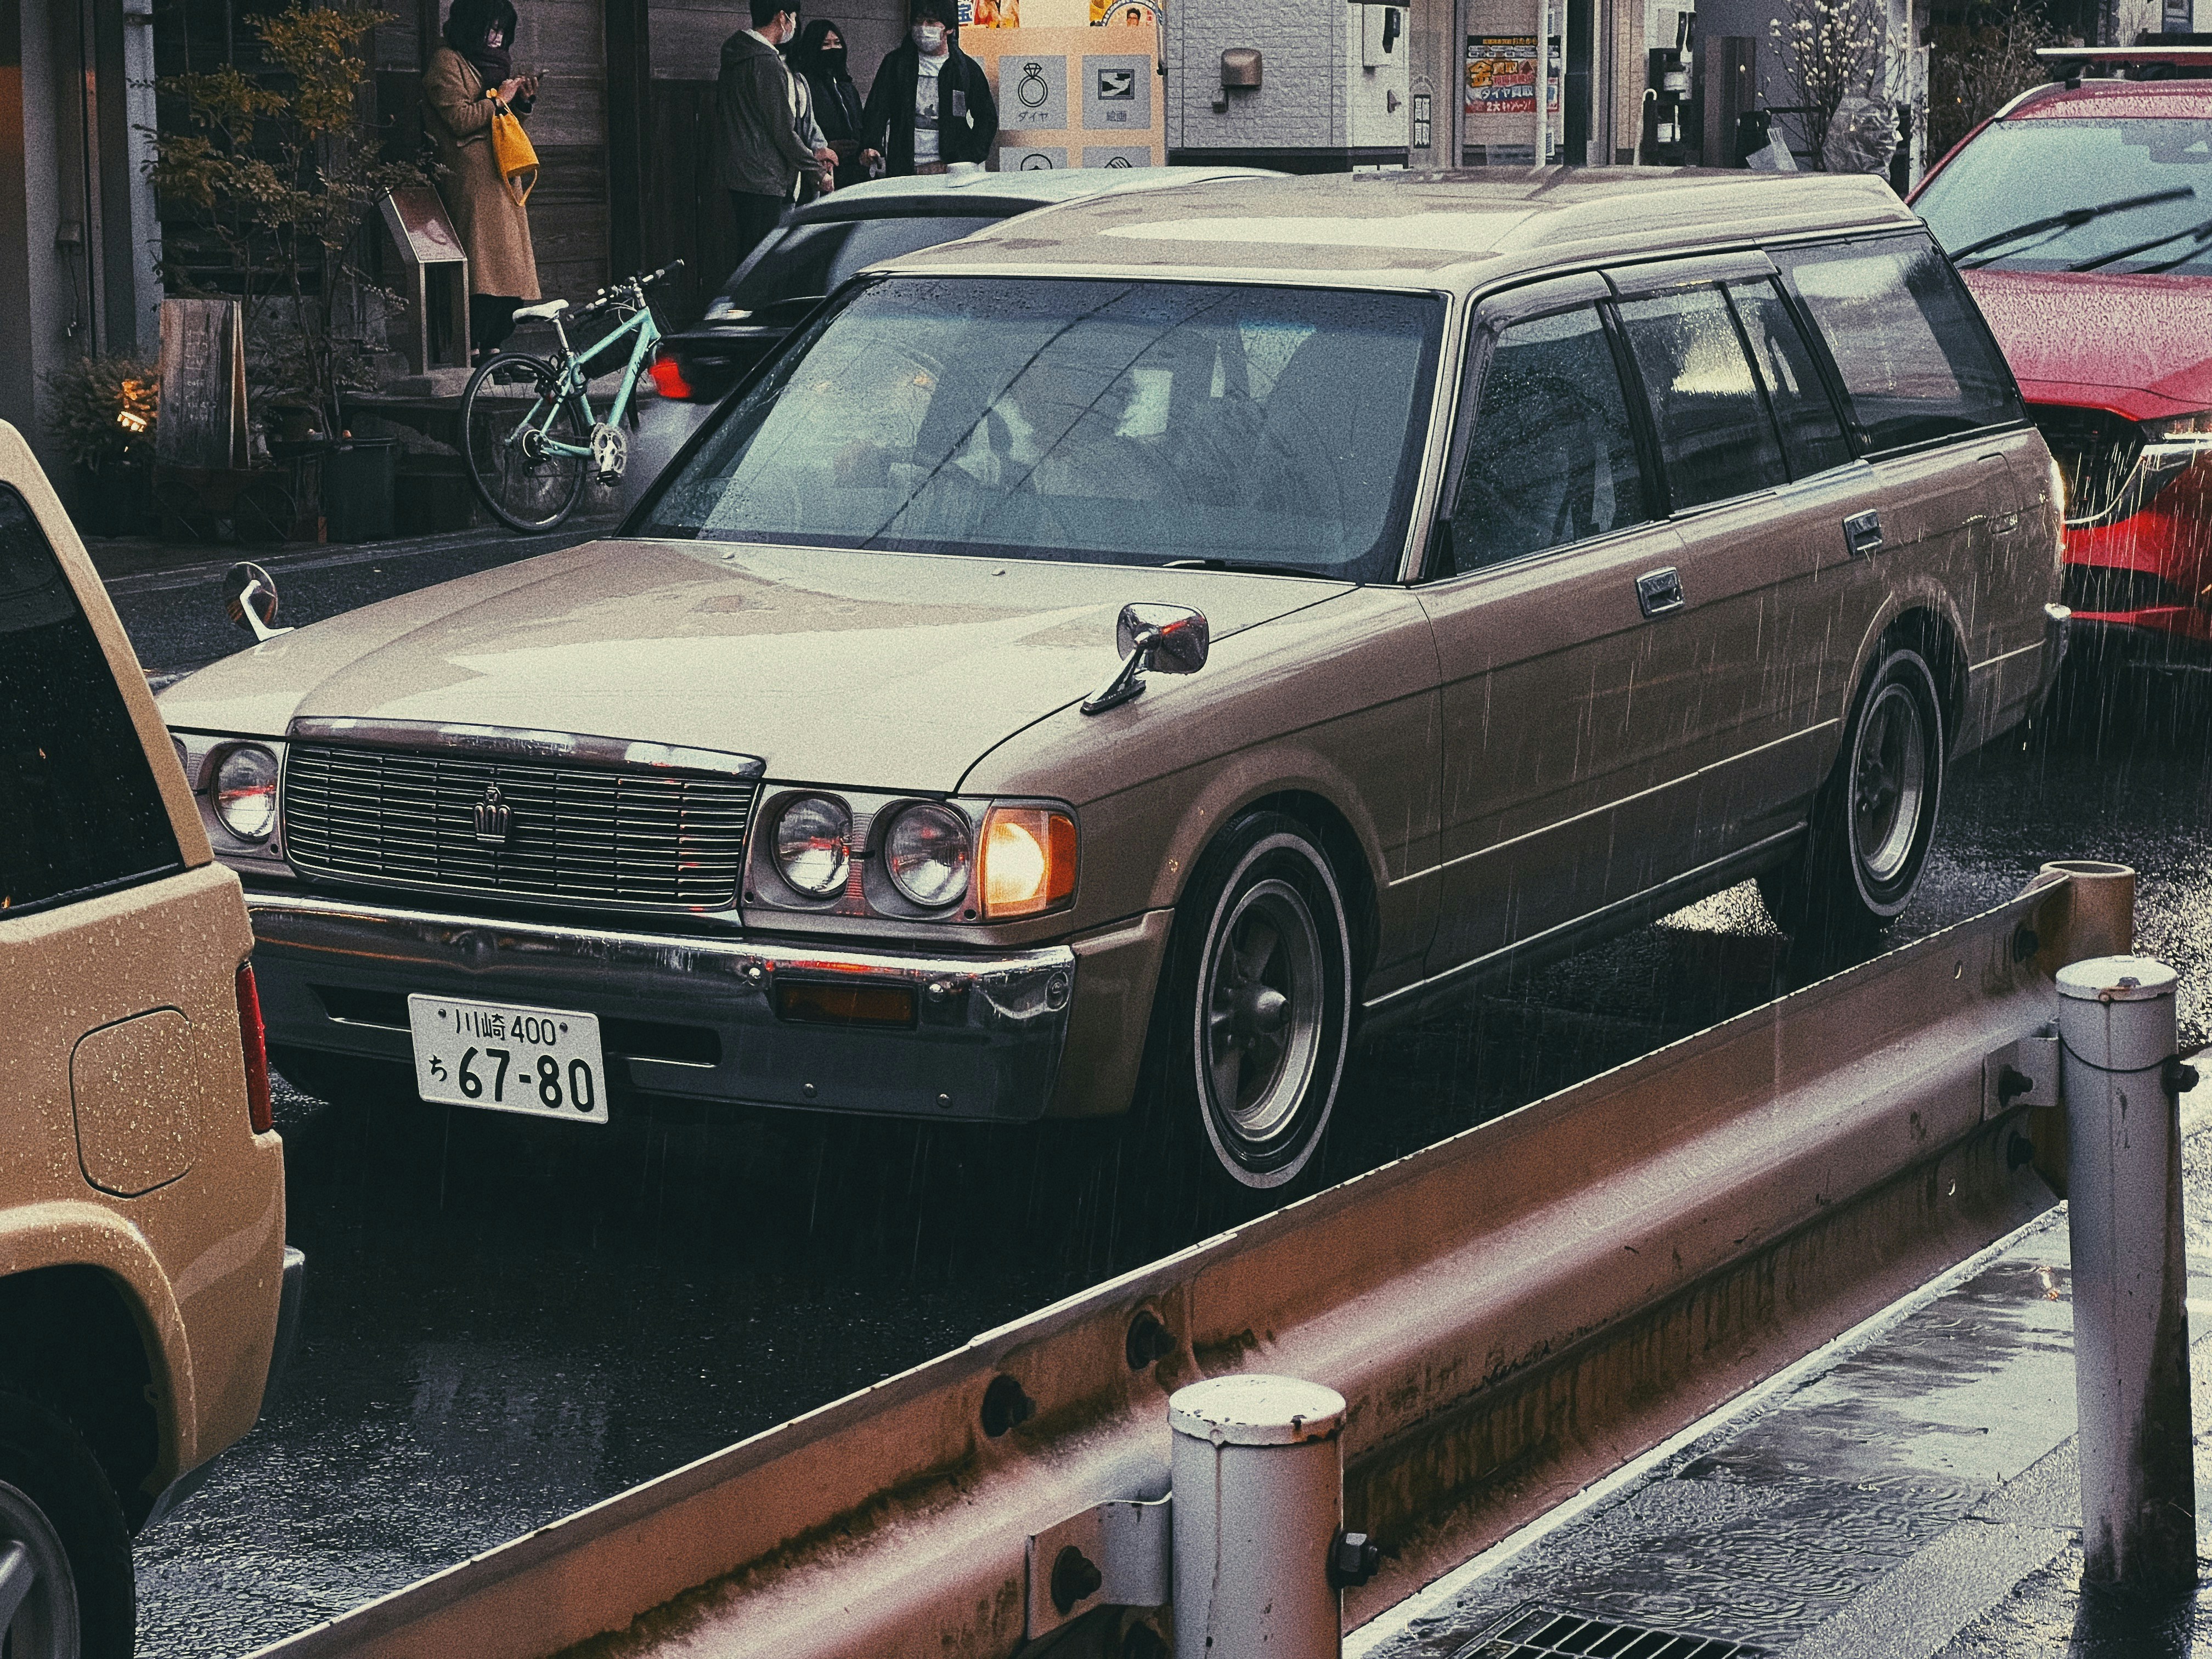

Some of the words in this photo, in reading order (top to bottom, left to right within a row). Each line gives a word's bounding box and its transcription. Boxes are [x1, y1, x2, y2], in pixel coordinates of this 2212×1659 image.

[1018, 111, 1048, 122] ダイヤ
[1106, 110, 1127, 122] 絵画
[456, 1009, 506, 1041] 川崎
[511, 1015, 556, 1046] 400
[428, 1055, 447, 1082] ち
[459, 1046, 595, 1113] 67-80
